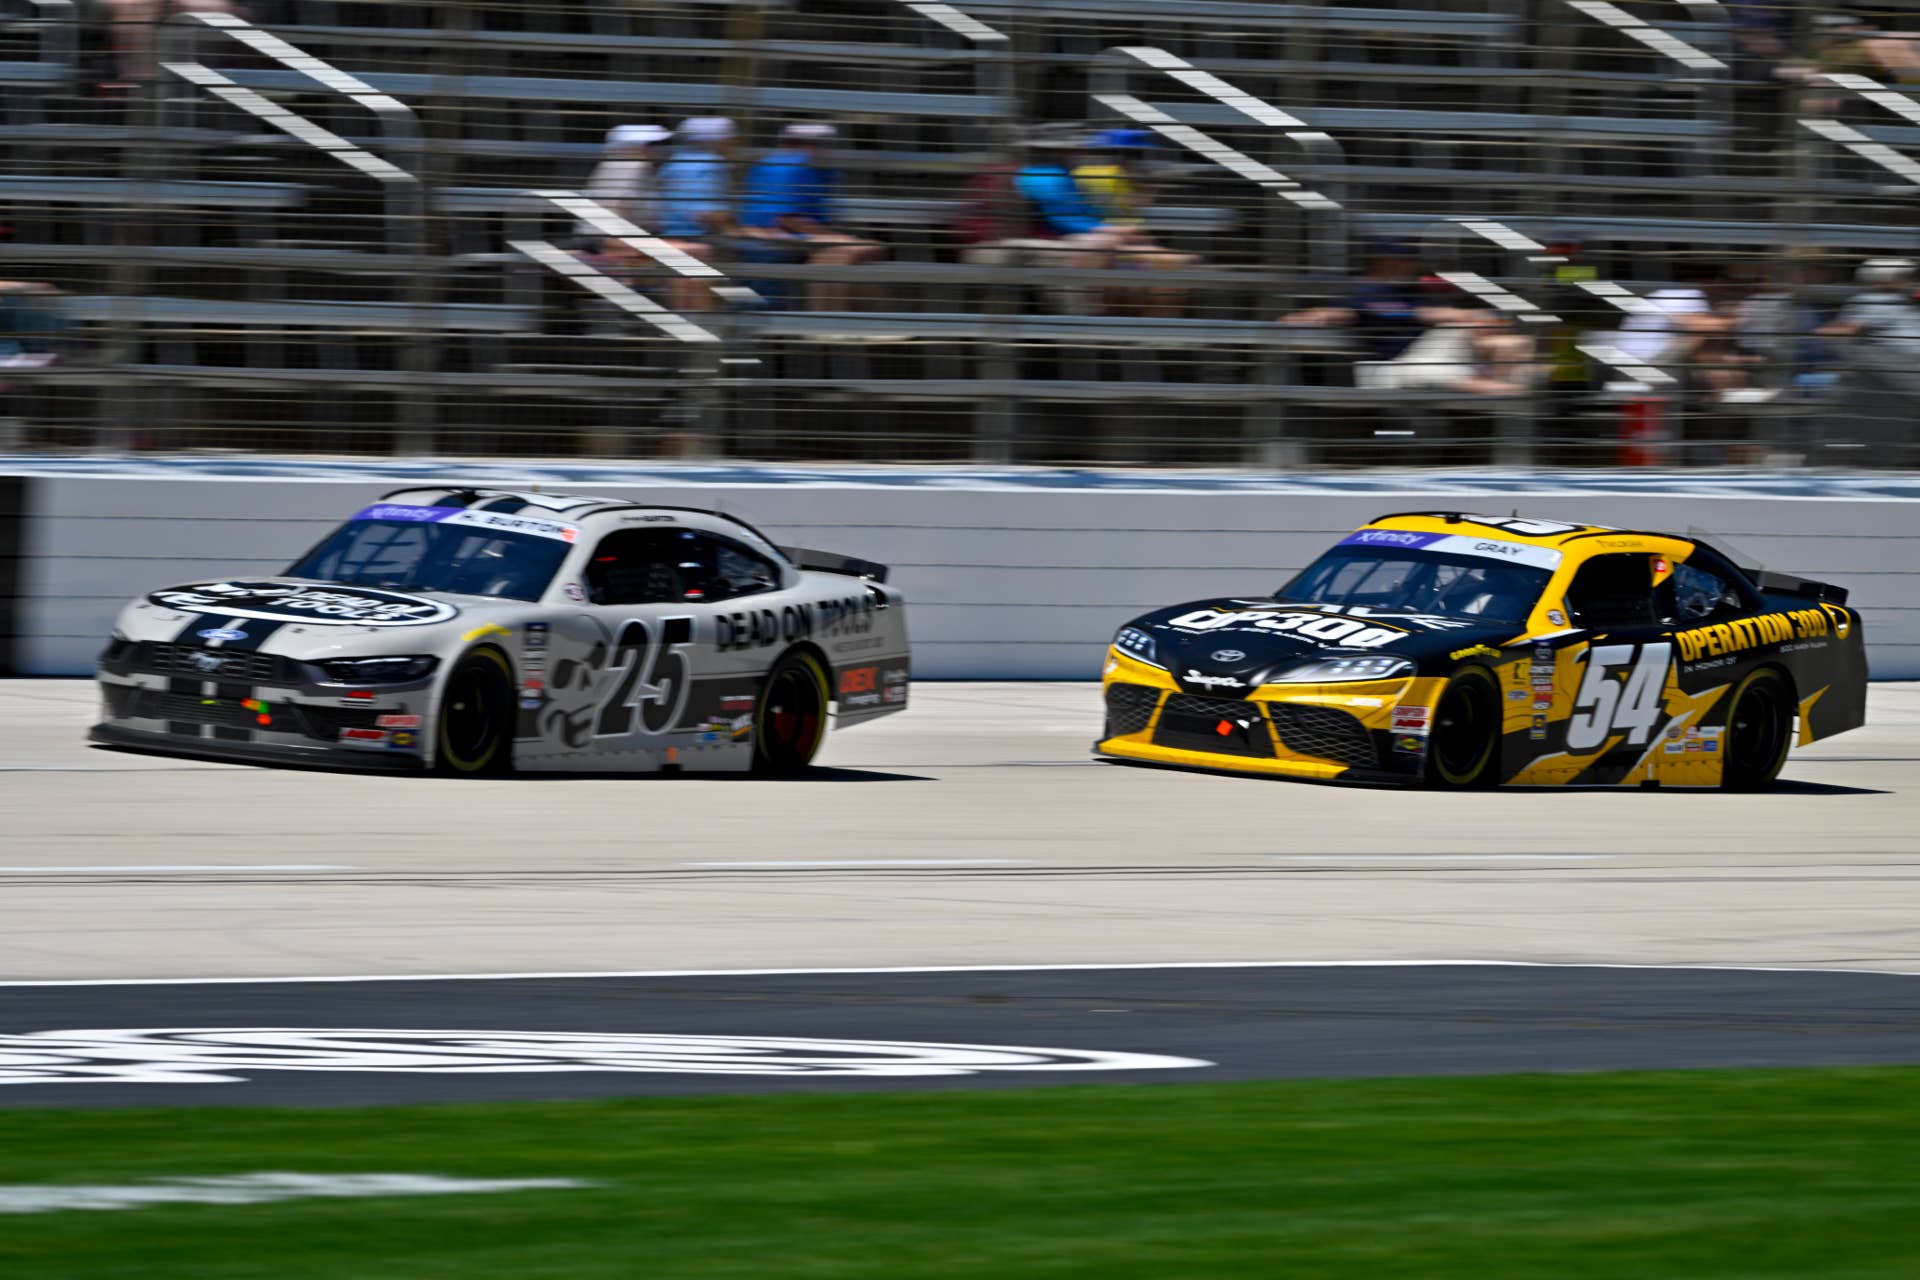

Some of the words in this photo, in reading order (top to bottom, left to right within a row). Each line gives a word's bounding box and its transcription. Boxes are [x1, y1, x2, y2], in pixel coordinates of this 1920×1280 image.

[1356, 530, 1424, 546] xfinity
[1474, 542, 1523, 556] GRAY
[715, 609, 779, 653] DEAD
[782, 602, 814, 643] ON
[1675, 612, 1795, 662] OPERATION
[1787, 608, 1828, 639] 300
[591, 614, 698, 738] 25
[1566, 642, 1672, 749] 54
